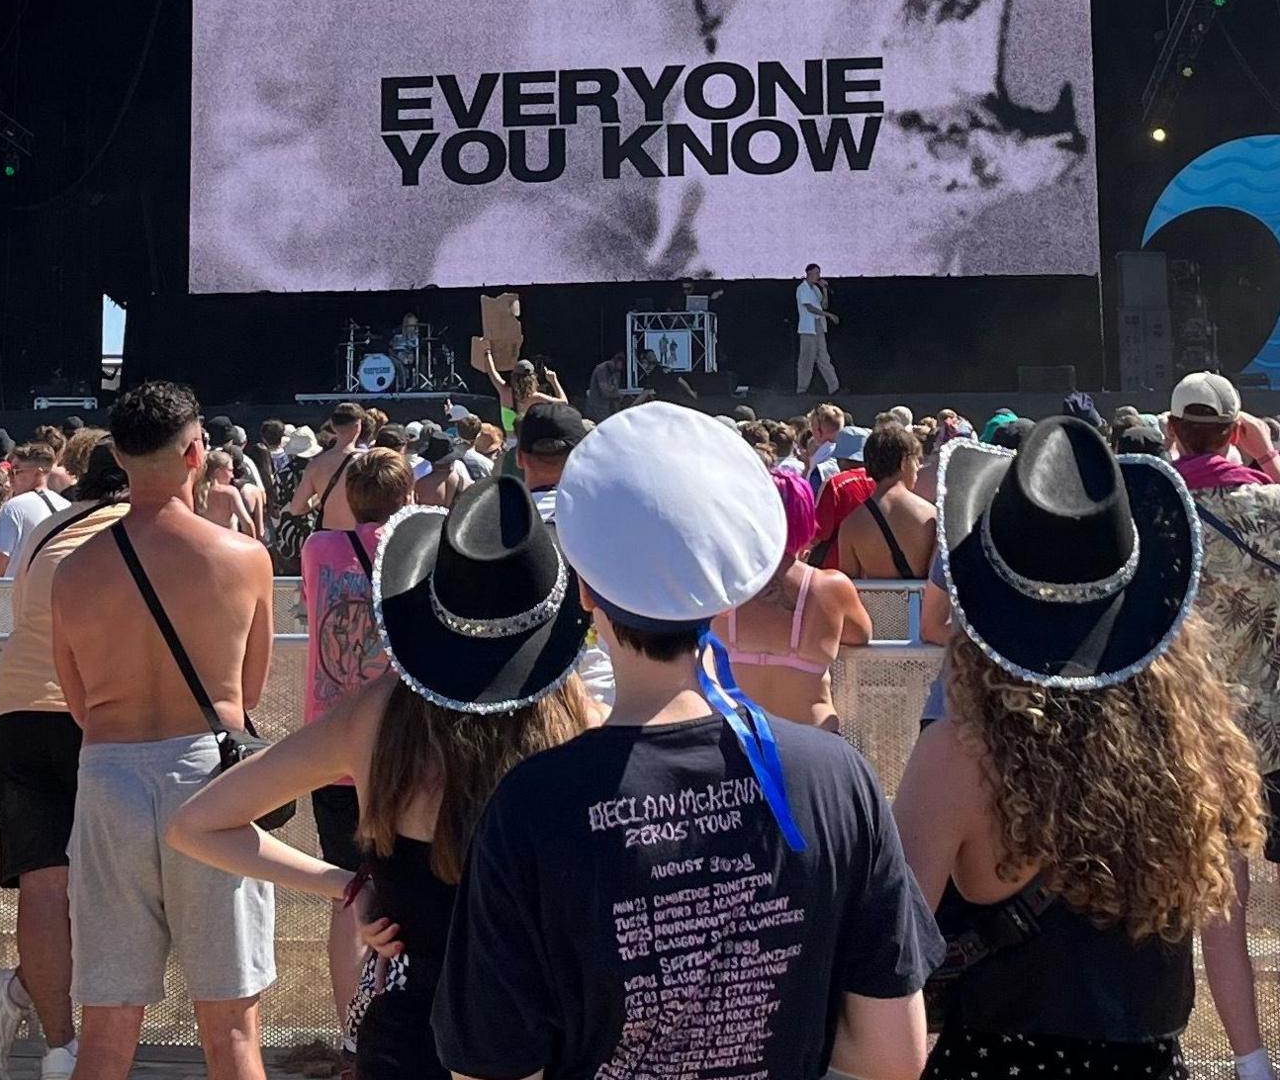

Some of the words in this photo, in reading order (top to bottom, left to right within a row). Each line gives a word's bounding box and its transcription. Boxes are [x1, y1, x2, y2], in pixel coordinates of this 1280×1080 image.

[379, 57, 884, 132] EVERYONE
[381, 127, 567, 187] YOU
[602, 116, 882, 180] KNOW
[588, 793, 675, 832] DECLAN
[625, 820, 689, 848] ZEROS
[695, 810, 743, 834] TOUR
[650, 856, 704, 880] AUGUST
[654, 931, 707, 953] GLASGOW
